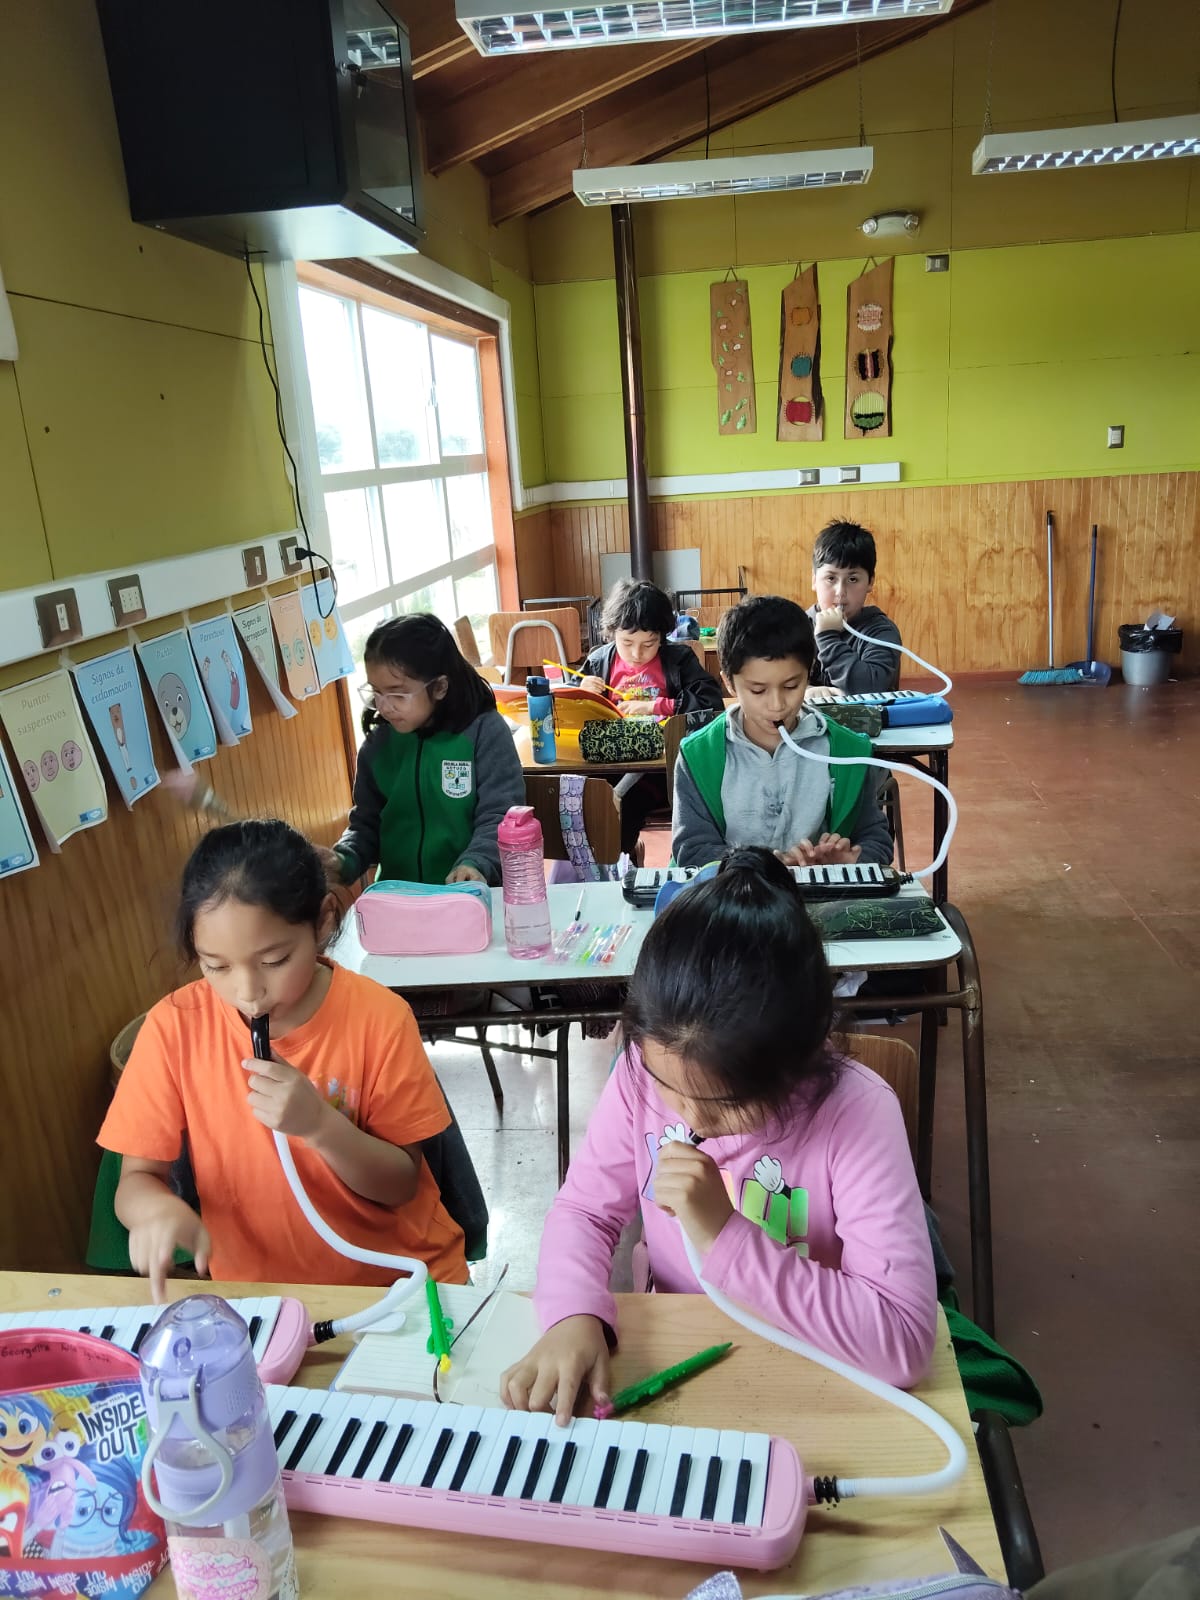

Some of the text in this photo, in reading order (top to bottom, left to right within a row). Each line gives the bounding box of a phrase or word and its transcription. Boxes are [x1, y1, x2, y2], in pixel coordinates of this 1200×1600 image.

[91, 664, 125, 686] Signos de
[21, 692, 51, 710] Puntos
[17, 709, 66, 736] suspensivos
[77, 1395, 147, 1442] INSIDE
[98, 1423, 138, 1462] OUT
